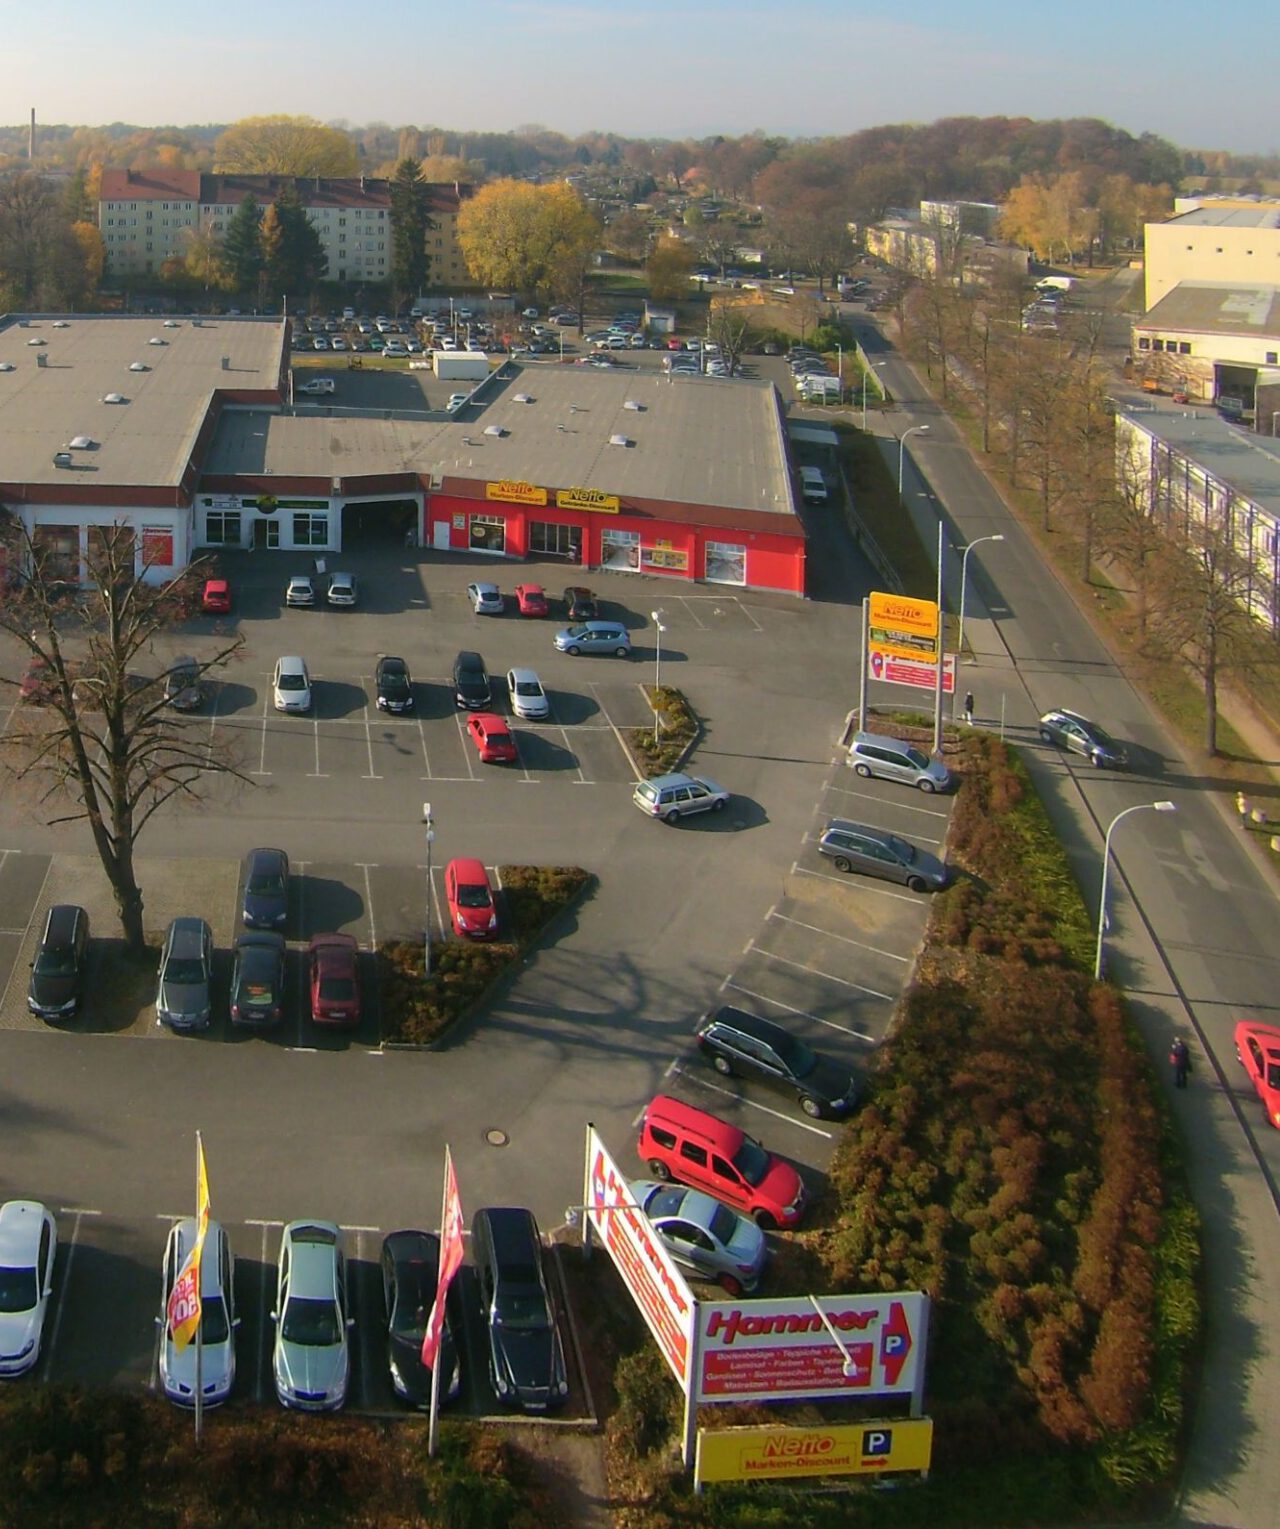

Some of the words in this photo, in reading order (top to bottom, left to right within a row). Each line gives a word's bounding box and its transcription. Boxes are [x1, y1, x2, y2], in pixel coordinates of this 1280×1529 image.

[499, 480, 535, 494] Netto
[569, 488, 607, 502] Netto
[884, 602, 923, 618] Netto
[608, 1168, 689, 1316] Hammer
[706, 1310, 879, 1344] Hammer
[886, 1336, 901, 1353] P
[763, 1434, 835, 1457] Netto
[869, 1433, 885, 1453] P
[745, 1456, 850, 1471] Marken-Discount
